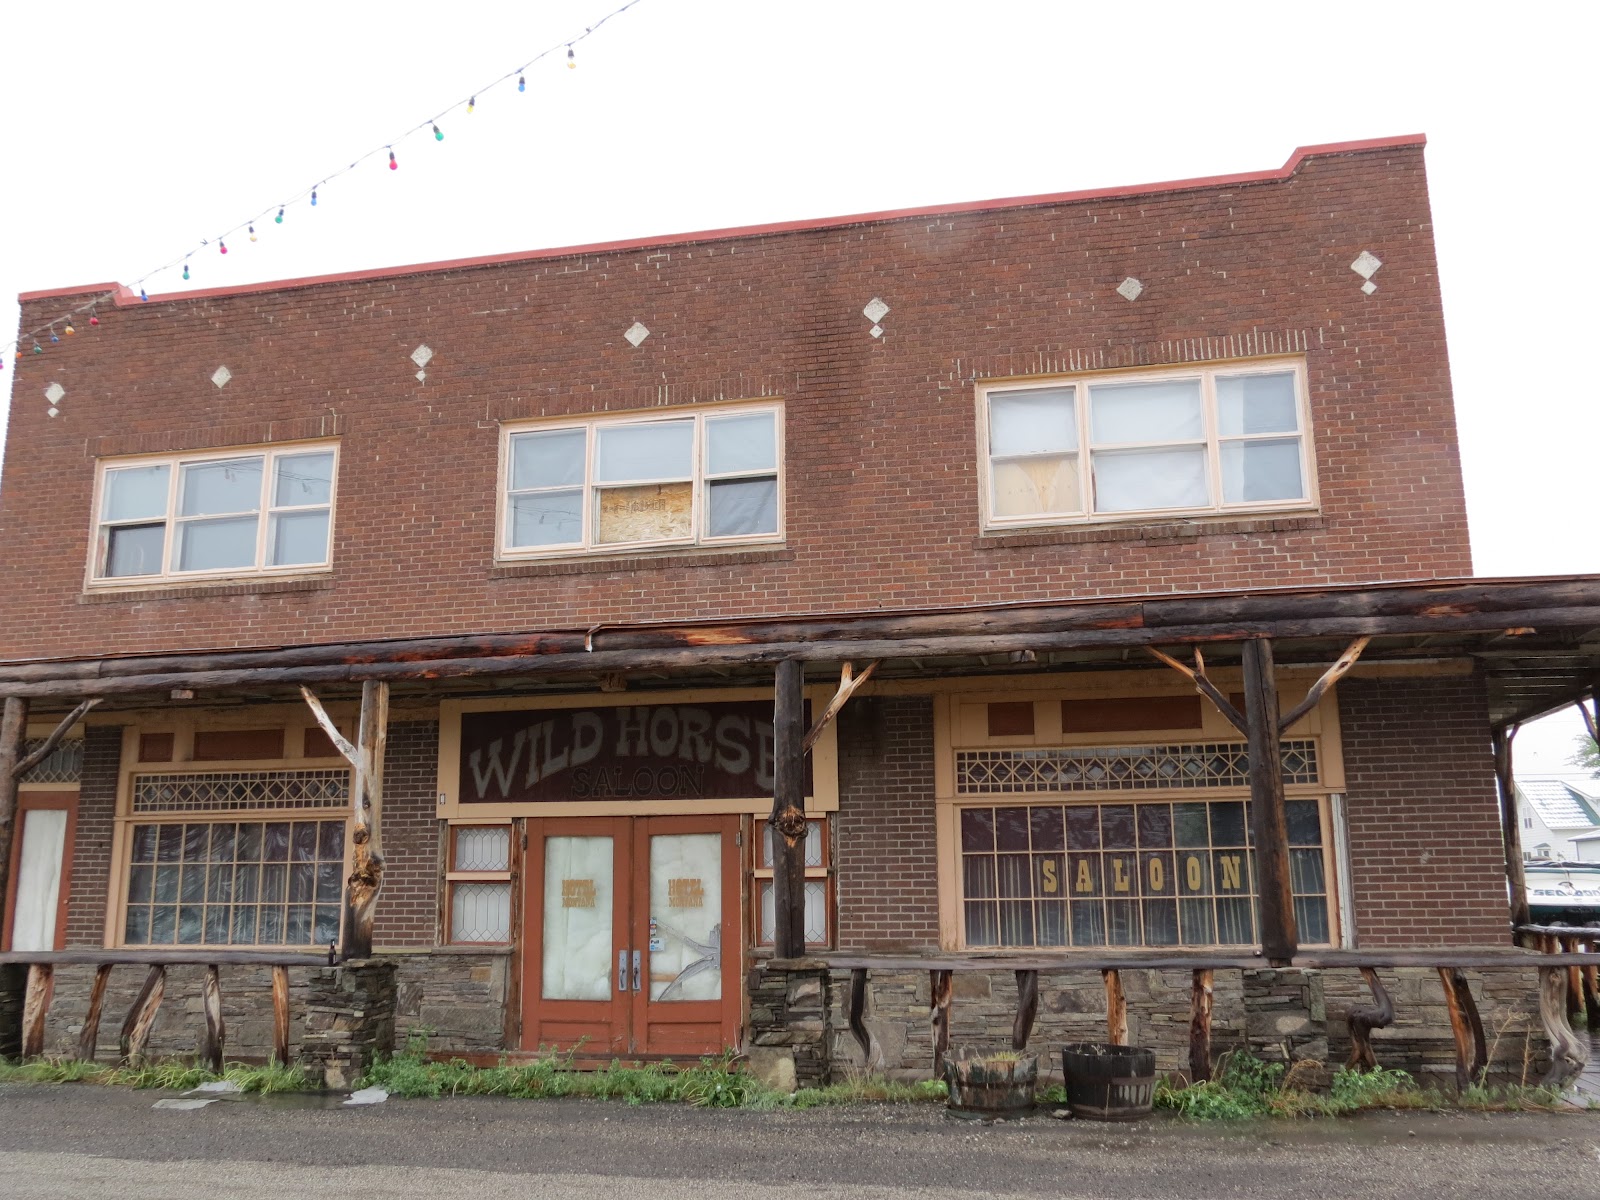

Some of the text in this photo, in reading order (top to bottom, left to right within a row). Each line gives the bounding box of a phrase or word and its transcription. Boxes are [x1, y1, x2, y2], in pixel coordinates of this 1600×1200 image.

[469, 711, 606, 799] WILD
[571, 764, 705, 799] SALOON
[667, 878, 705, 897] HOTEL
[1042, 855, 1241, 893] SALOON
[562, 896, 596, 908] MONTANA
[668, 896, 704, 908] MONTANA
